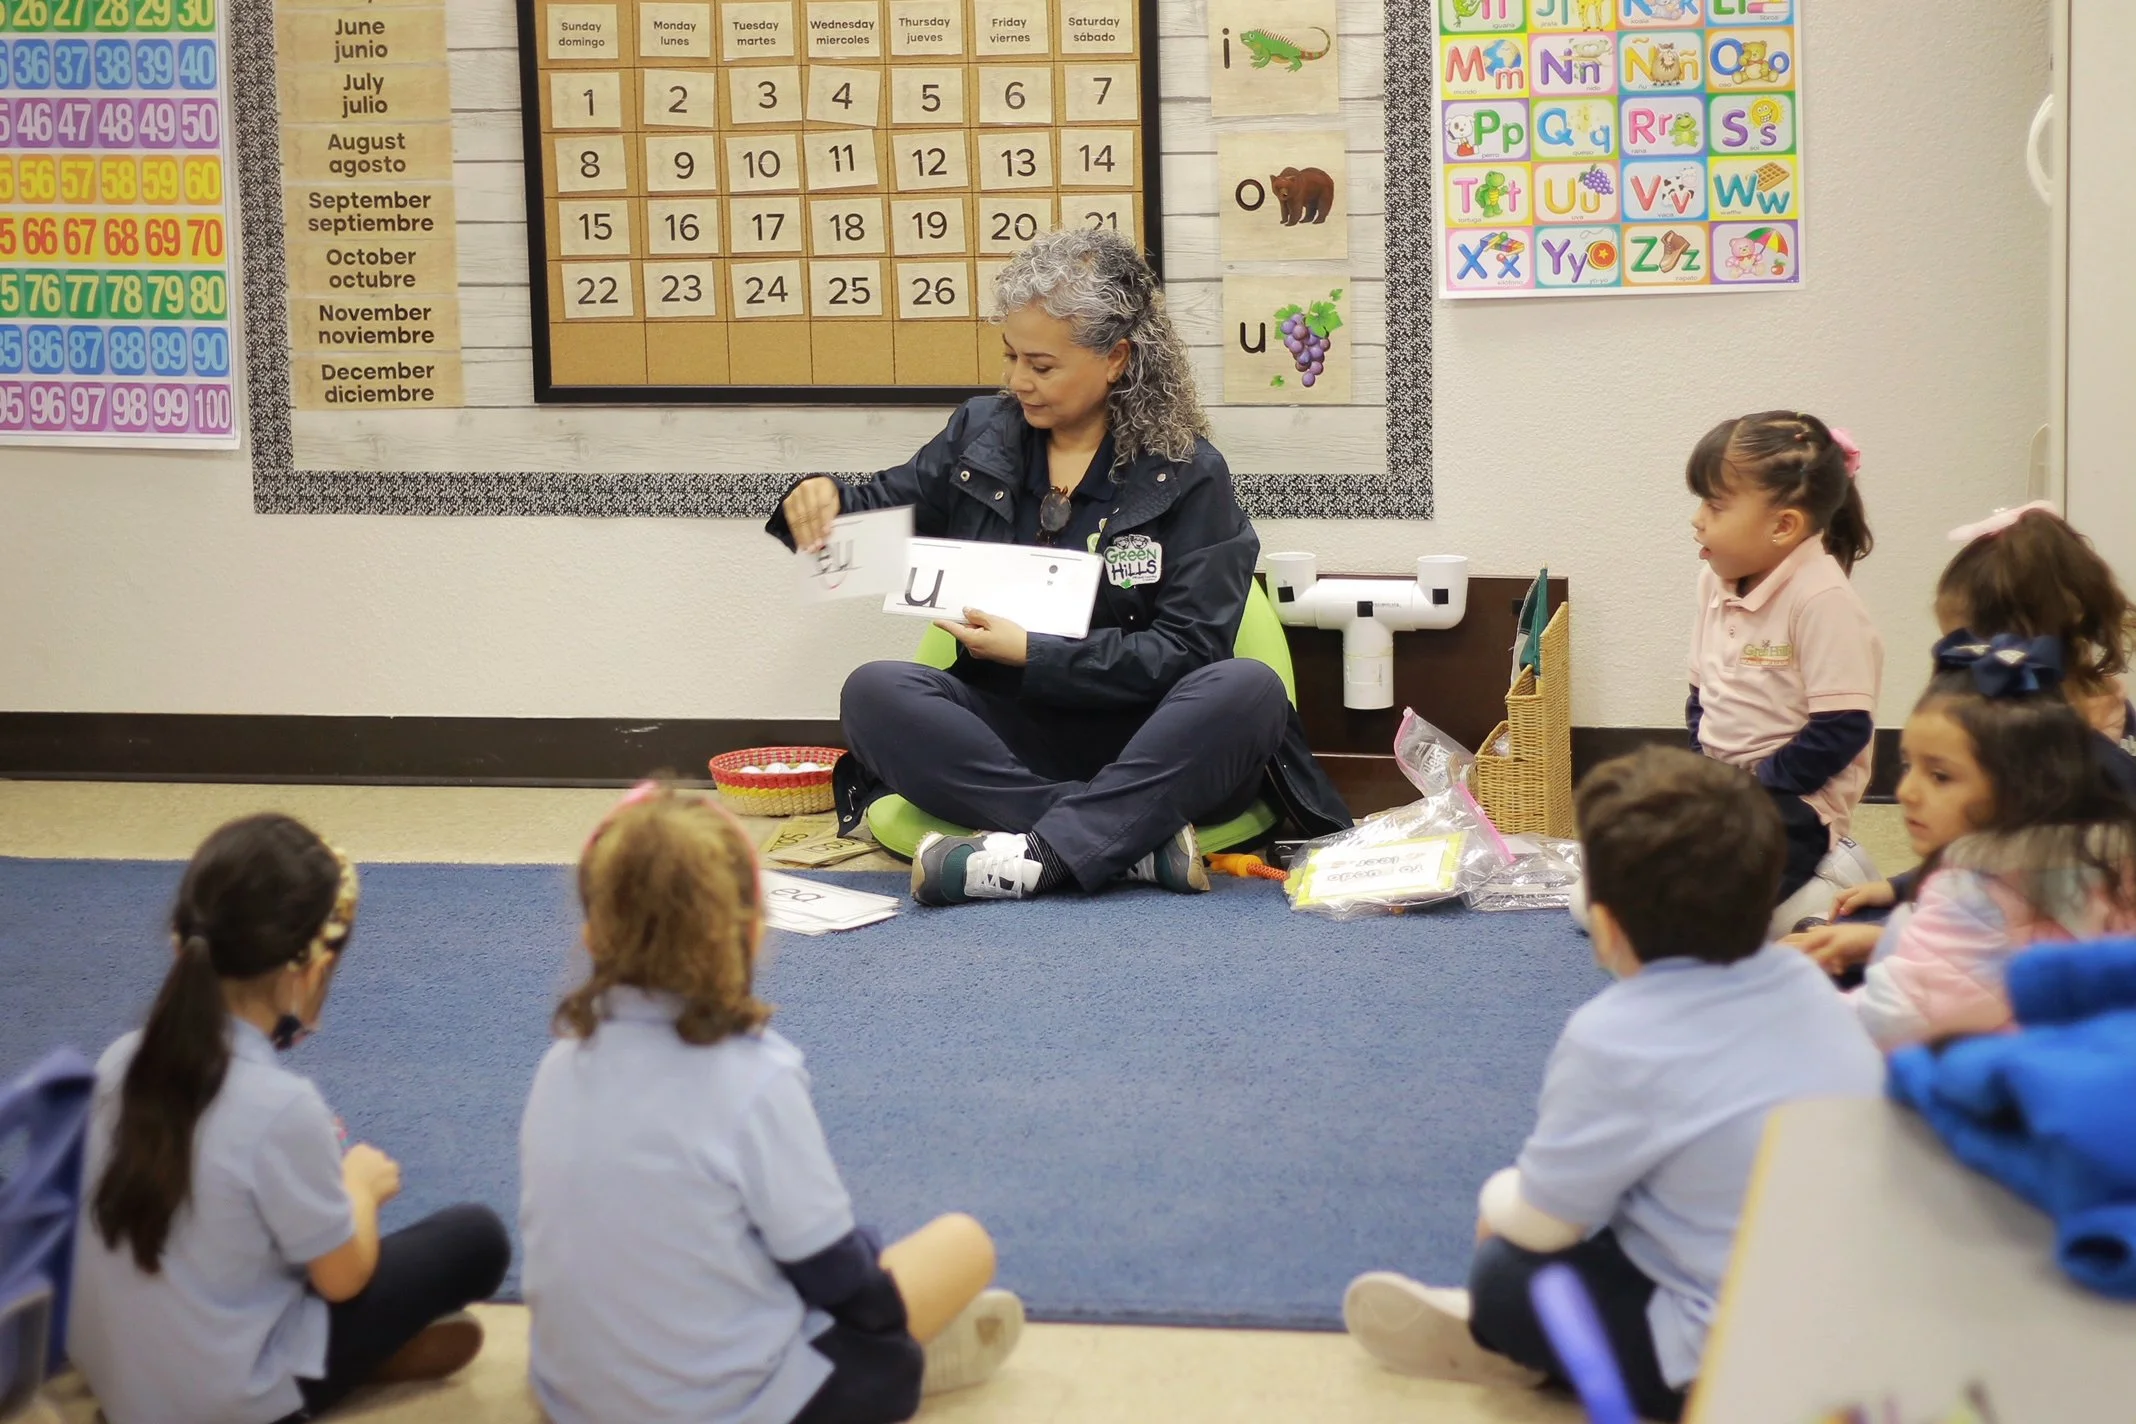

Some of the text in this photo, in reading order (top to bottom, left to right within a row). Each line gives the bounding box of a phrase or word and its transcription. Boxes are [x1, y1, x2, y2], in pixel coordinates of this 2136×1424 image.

[12, 0, 47, 27] 26
[53, 0, 86, 27] 27
[95, 0, 129, 27] 28
[136, 0, 171, 27] 29
[178, 0, 213, 26] 30
[562, 17, 1120, 33] Sunday Monday Tuesday Wednesday Thursday Friday Saturday
[335, 19, 385, 35] June
[334, 40, 388, 63] junio
[558, 32, 1115, 49] domingo lunes martes miercoles jueves viernes sábado
[1223, 28, 1230, 69] i
[14, 46, 49, 84] 36
[55, 46, 89, 84] 37
[96, 46, 132, 84] 38
[137, 46, 173, 84] 39
[180, 46, 215, 84] 40
[343, 73, 384, 94] July
[342, 96, 388, 118] julio
[583, 77, 1112, 116] 1 2 3 4 5 6 7
[17, 103, 53, 141] 46
[58, 103, 91, 141] 47
[99, 103, 134, 142] 48
[140, 104, 175, 142] 49
[182, 104, 218, 142] 50
[328, 133, 405, 154] August
[329, 156, 406, 177] agosto
[581, 145, 1115, 179] 8 9 10 11 12 13 14
[20, 160, 56, 199] 56
[61, 161, 95, 199] 57
[102, 161, 136, 199] 58
[143, 161, 178, 200] 59
[185, 161, 221, 200] 60
[309, 191, 431, 212] September
[1235, 179, 1265, 211] o
[308, 214, 434, 235] septiembre
[579, 212, 1117, 241] 15 16 17 18 19 20 21
[0, 218, 222, 257] 5 66 67 68 69 70
[327, 248, 416, 265] October
[329, 271, 416, 288] octubre
[577, 275, 955, 305] 22 23 24 25 26
[0, 275, 226, 314] 5 76 77 78 79 80
[320, 304, 432, 321] November
[319, 327, 434, 344] noviembre
[1240, 322, 1266, 354] u
[0, 330, 227, 370] 5 86 87 88 89 90
[322, 362, 435, 380] December
[325, 385, 434, 403] diciembre
[0, 386, 230, 429] 5 96 97 98 99 100
[905, 567, 944, 607] u
